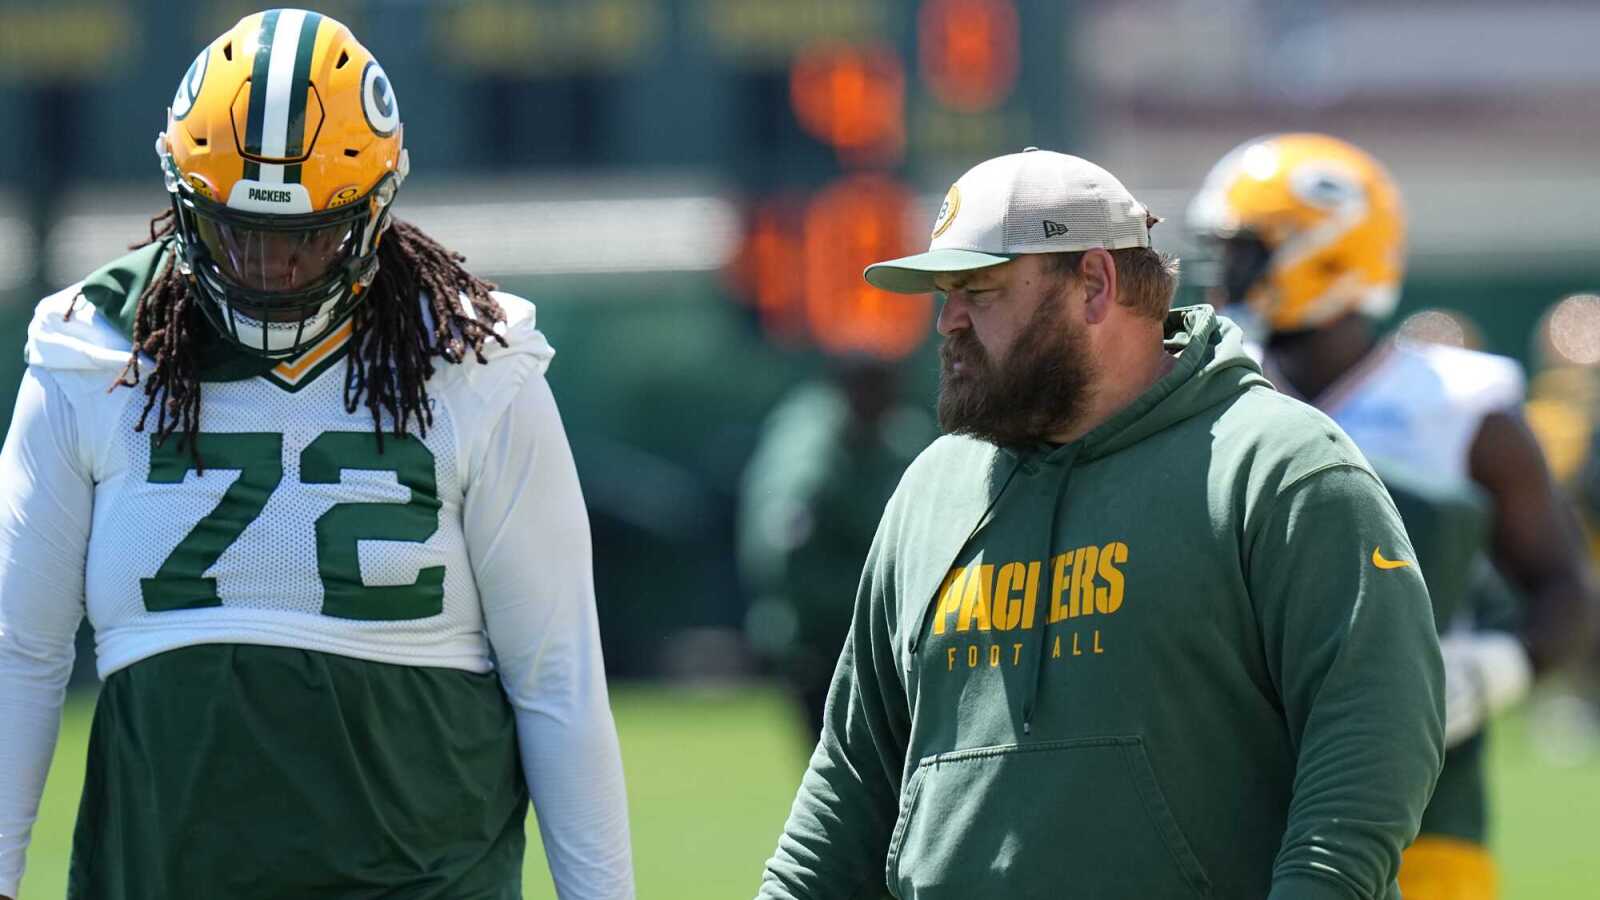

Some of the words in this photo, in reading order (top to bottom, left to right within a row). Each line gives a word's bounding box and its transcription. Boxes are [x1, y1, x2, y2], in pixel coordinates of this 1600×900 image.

[248, 187, 292, 203] PACKERS
[140, 431, 446, 621] 72
[947, 629, 1104, 673] FOOTALL
